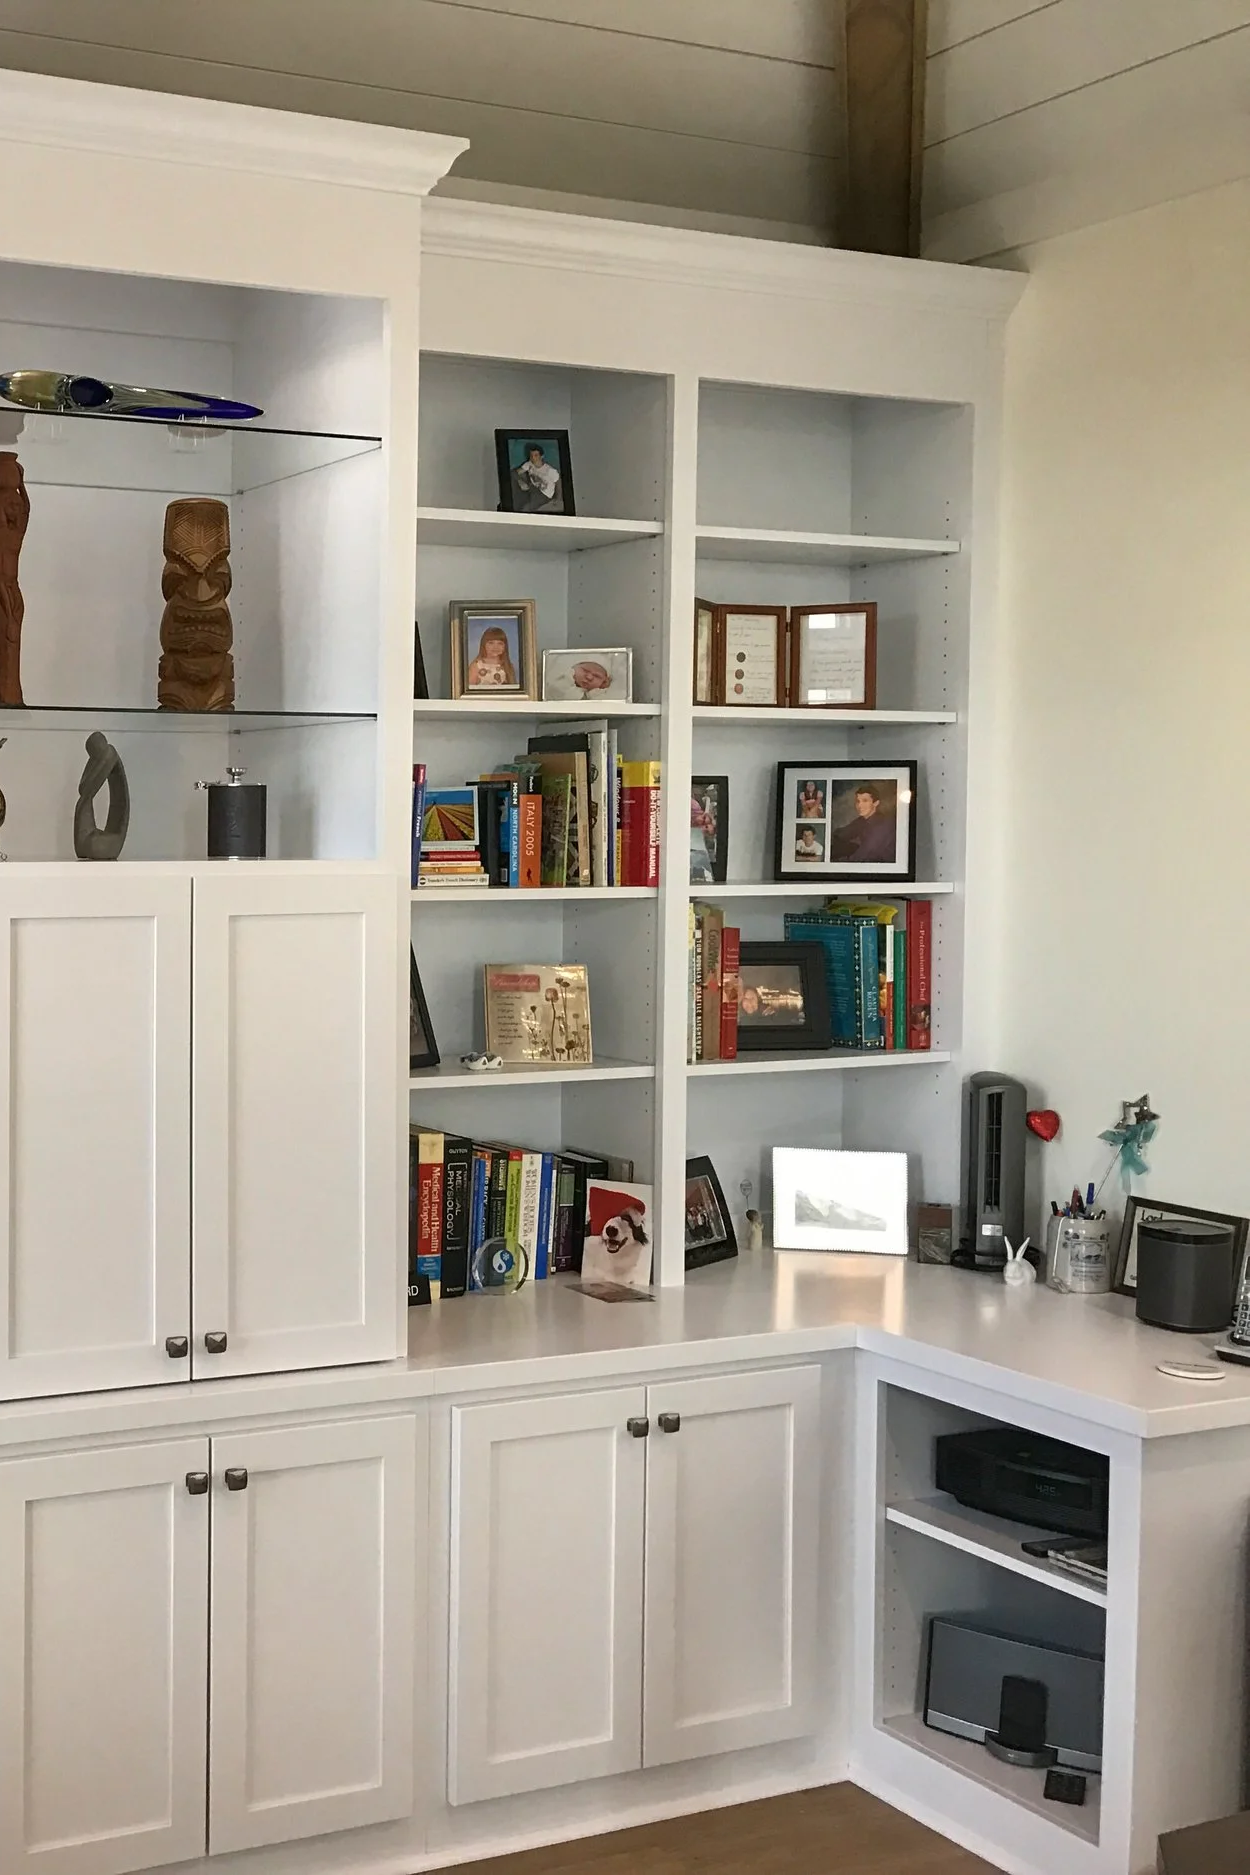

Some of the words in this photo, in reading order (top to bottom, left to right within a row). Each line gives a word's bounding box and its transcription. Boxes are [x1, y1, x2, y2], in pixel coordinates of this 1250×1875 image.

[526, 802, 535, 827] ITALY
[526, 830, 535, 856] 2005
[918, 930, 926, 980] Professional
[431, 1167, 441, 1202] Medical
[420, 1180, 432, 1239] Encyclopedia
[431, 1203, 440, 1220] and
[446, 1170, 454, 1236] PHYSIOLOGY
[430, 1221, 440, 1252] Health
